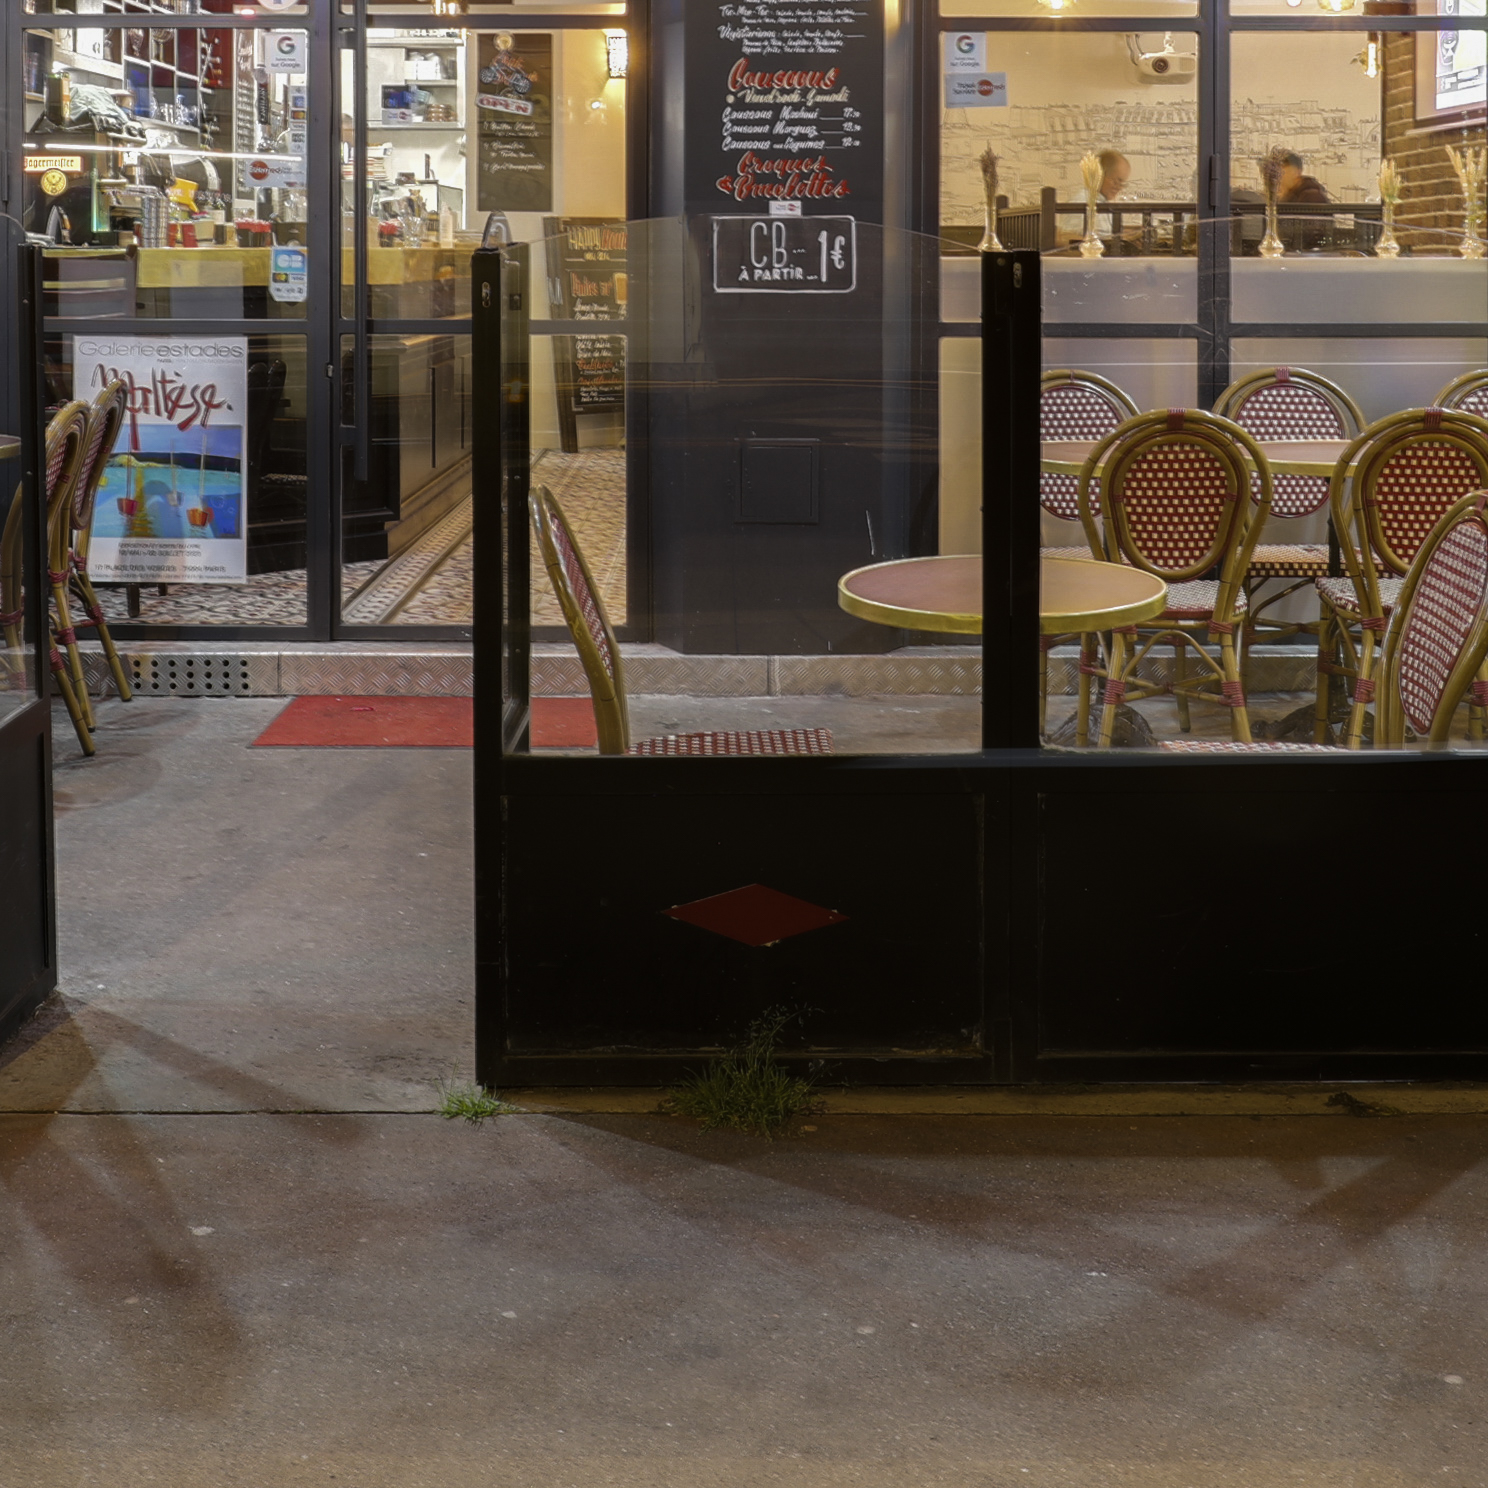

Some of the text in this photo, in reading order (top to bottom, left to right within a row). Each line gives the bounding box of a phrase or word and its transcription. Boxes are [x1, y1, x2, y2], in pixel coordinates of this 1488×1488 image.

[277, 36, 296, 55] G
[956, 35, 975, 53] G
[725, 57, 840, 93] Couscous
[478, 96, 530, 115] OPEN
[722, 106, 773, 122] Couscous
[722, 121, 770, 136] Couscous
[721, 136, 771, 151] Couscous
[737, 151, 834, 179] Croques
[734, 172, 852, 201] Omelettes
[750, 221, 788, 269] CB
[738, 264, 804, 282] À PARTIR
